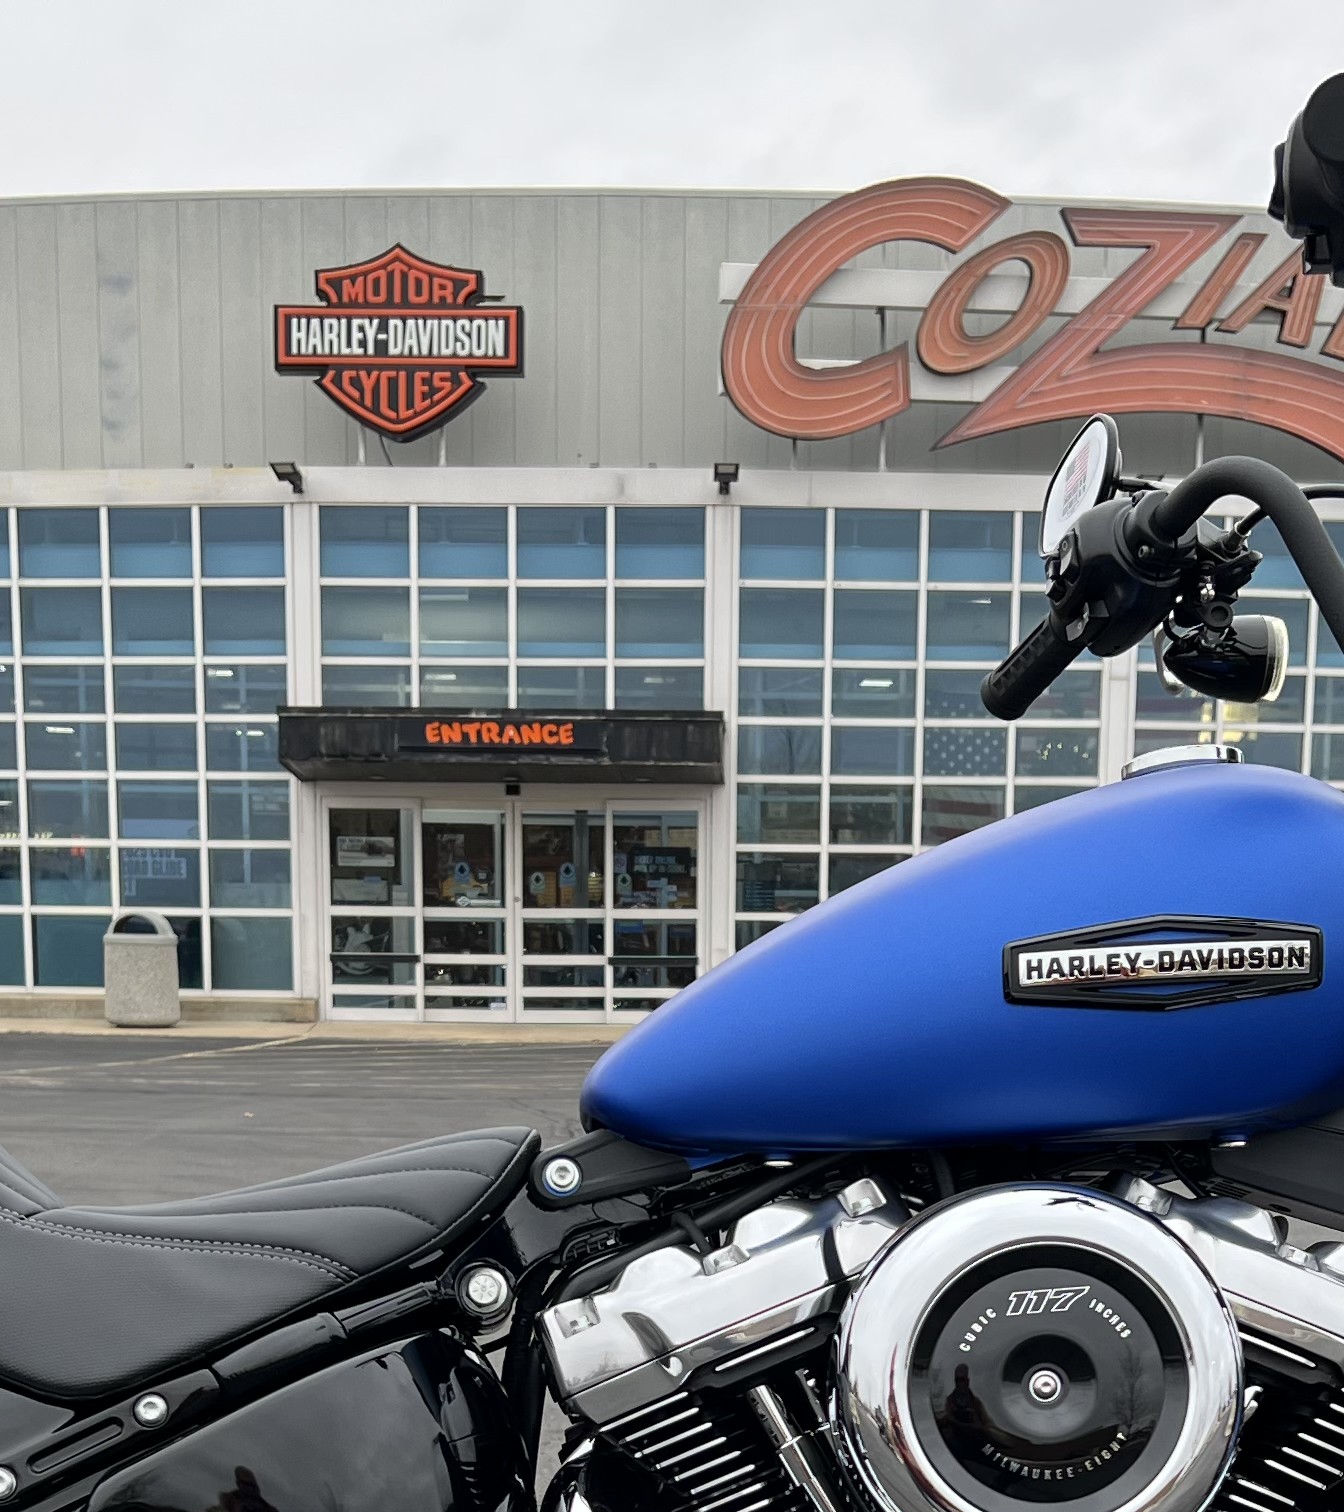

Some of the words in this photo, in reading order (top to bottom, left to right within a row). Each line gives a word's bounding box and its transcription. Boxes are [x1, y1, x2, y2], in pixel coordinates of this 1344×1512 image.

[341, 262, 455, 304] MOTOR
[290, 317, 505, 357] HARLEY-DAVIDSON
[341, 370, 453, 420] CYCLES
[424, 720, 575, 746] ENTRANCE
[1026, 945, 1307, 981] HARLEY-DAVIDSON
[959, 1308, 997, 1352] CUBIC
[1006, 1286, 1090, 1316] 117
[1089, 1298, 1131, 1338] INCHES
[981, 1432, 1128, 1480] MILWAUKEE-EIGHT
